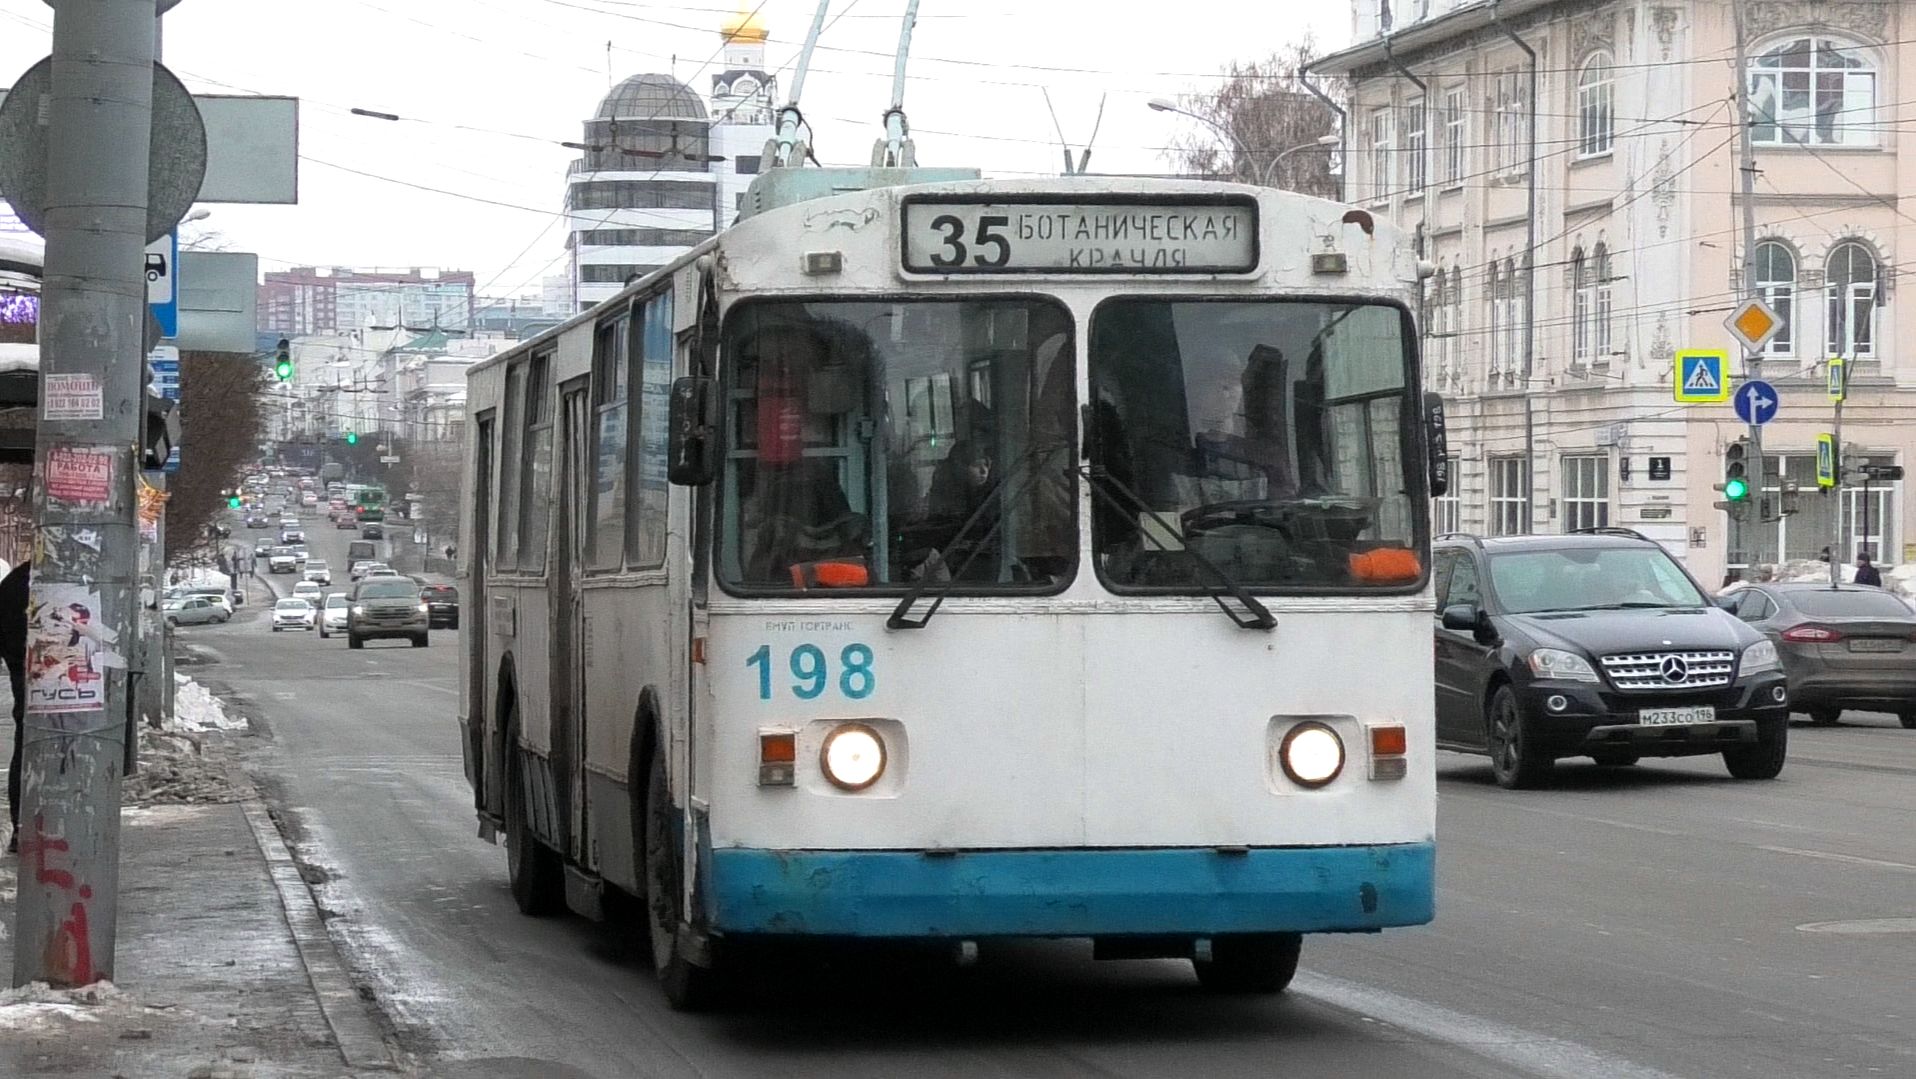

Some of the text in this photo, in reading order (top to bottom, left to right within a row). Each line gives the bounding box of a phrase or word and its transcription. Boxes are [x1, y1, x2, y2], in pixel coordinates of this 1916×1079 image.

[929, 215, 1011, 267] 35
[1018, 214, 1238, 241] БОТАНИЧЕСКАЯ
[57, 462, 101, 473] РАБОТА
[746, 643, 875, 700] 198
